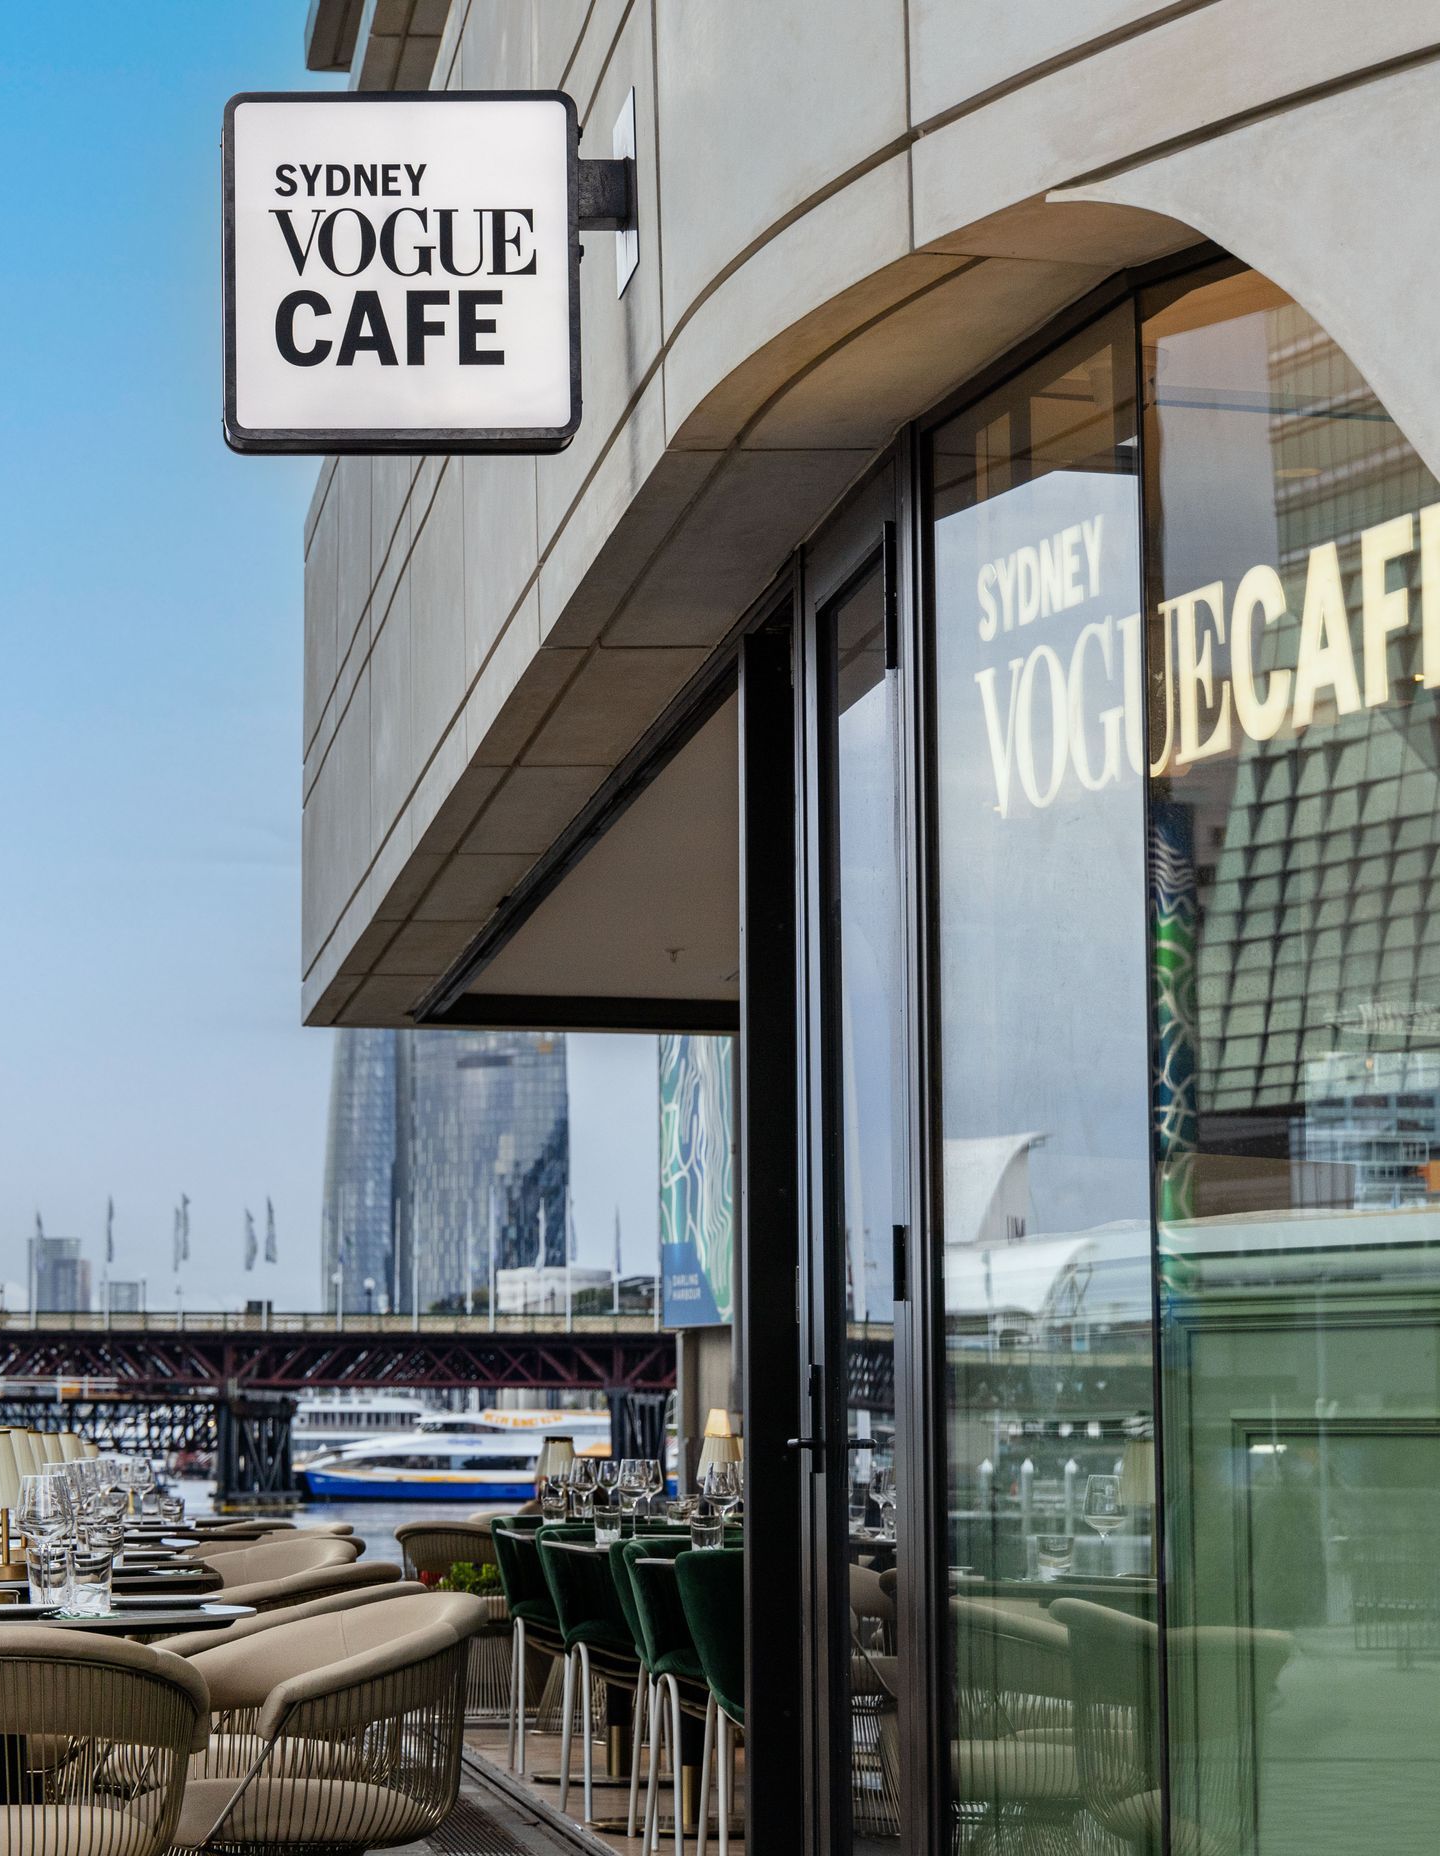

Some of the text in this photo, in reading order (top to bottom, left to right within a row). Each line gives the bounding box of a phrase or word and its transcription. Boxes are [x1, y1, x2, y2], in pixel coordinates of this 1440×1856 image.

[274, 163, 427, 198] SYDNEY
[268, 206, 537, 277] VOGUE
[274, 289, 505, 367] CAFE
[977, 514, 1104, 642] SYDNEY
[974, 581, 1231, 819] VOGUE
